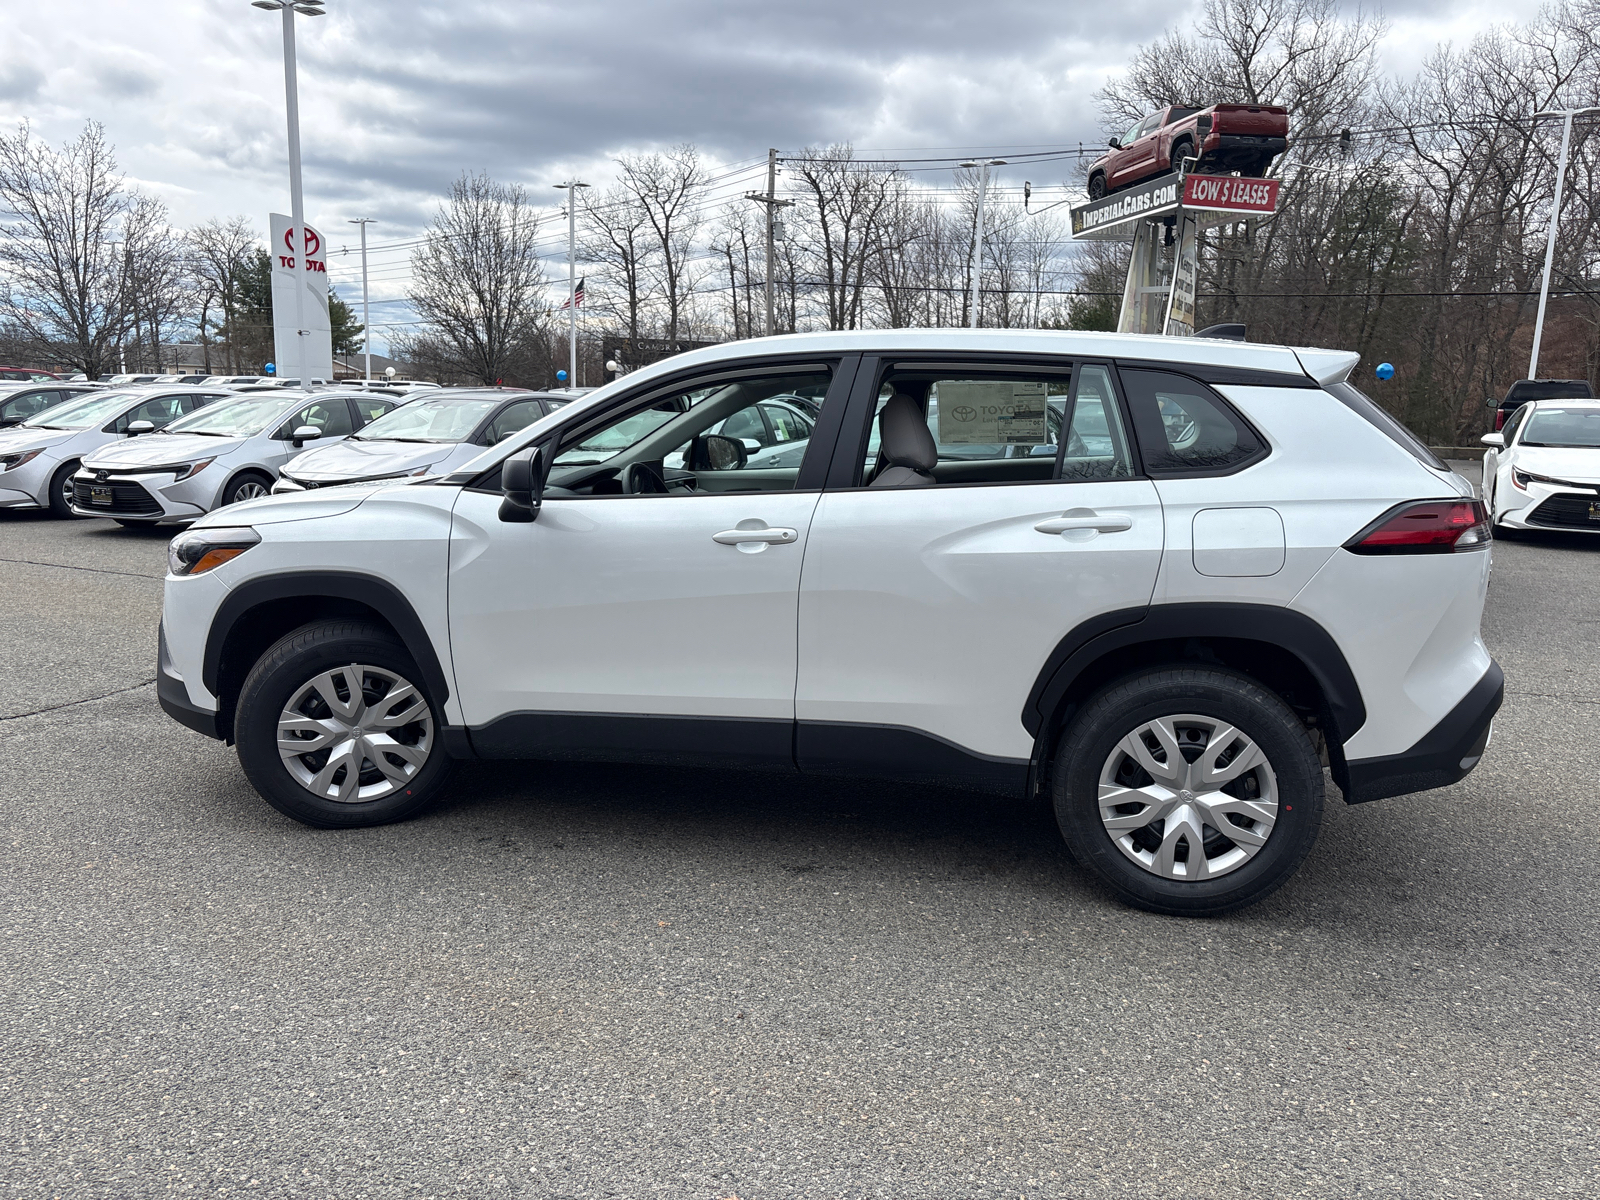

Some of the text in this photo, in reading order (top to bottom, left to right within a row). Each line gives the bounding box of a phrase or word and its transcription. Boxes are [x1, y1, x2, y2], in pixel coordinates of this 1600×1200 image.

[1192, 179, 1270, 205] LOW $ LEASES
[1082, 184, 1177, 229] IMPERIALCARS.COM
[279, 255, 326, 273] TOOTA
[637, 341, 682, 352] CAMBRA
[980, 404, 1032, 415] TOYOTA
